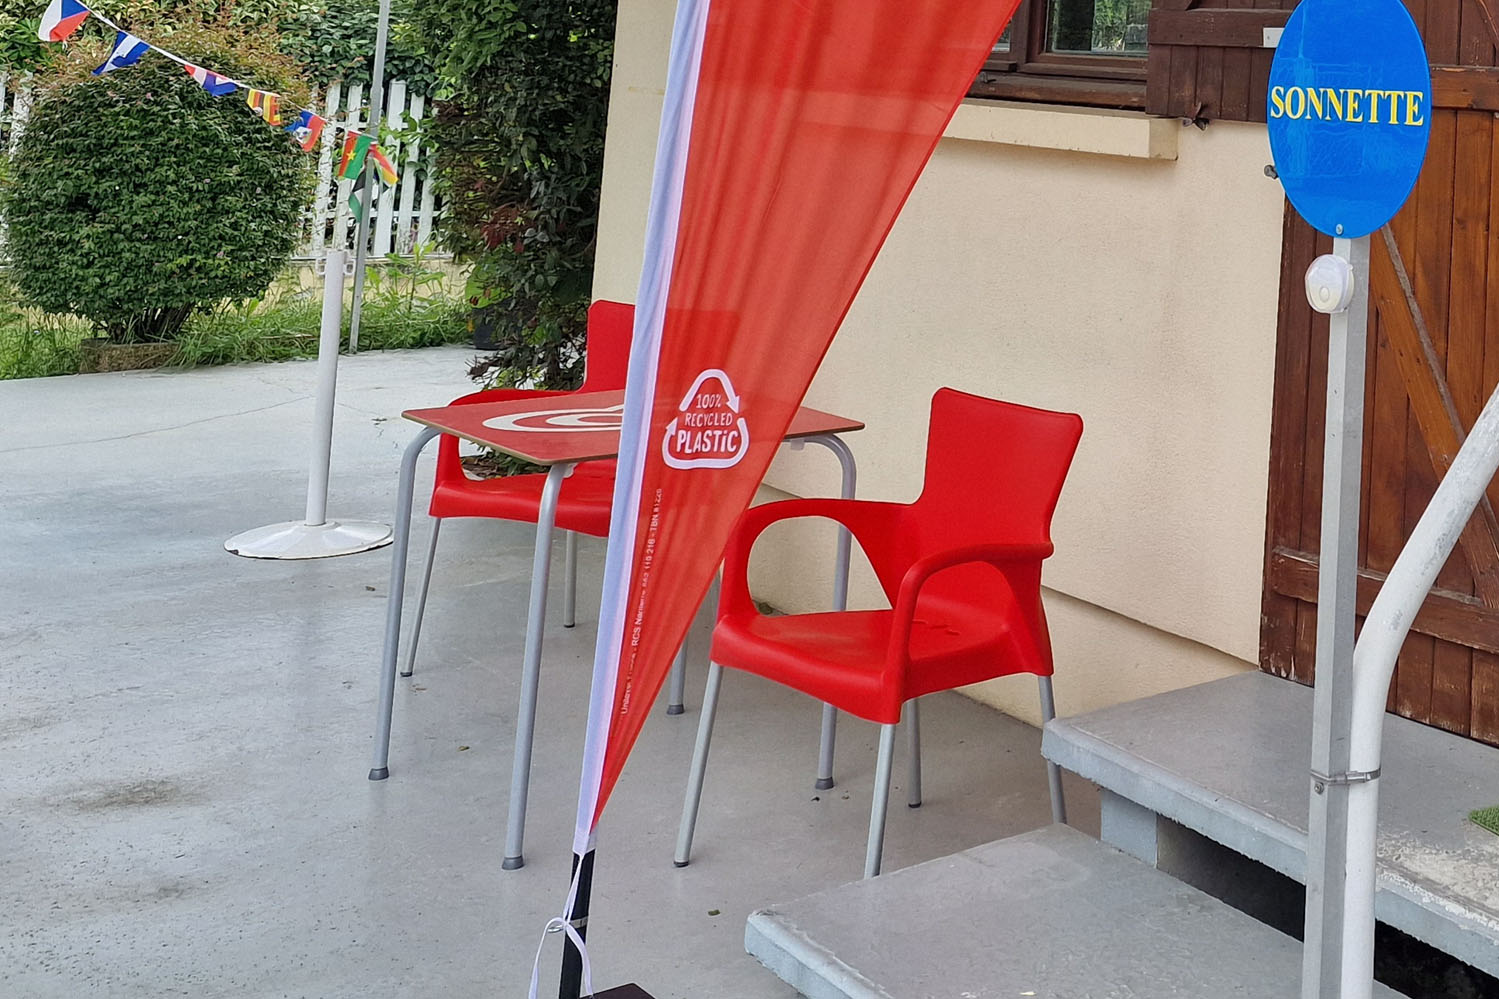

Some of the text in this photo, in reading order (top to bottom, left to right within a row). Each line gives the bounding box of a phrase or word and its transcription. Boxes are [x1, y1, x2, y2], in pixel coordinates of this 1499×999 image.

[1270, 86, 1424, 127] SONNETTE
[696, 394, 721, 409] 100%
[685, 413, 733, 427] RECYCLED
[631, 626, 641, 647] RCS
